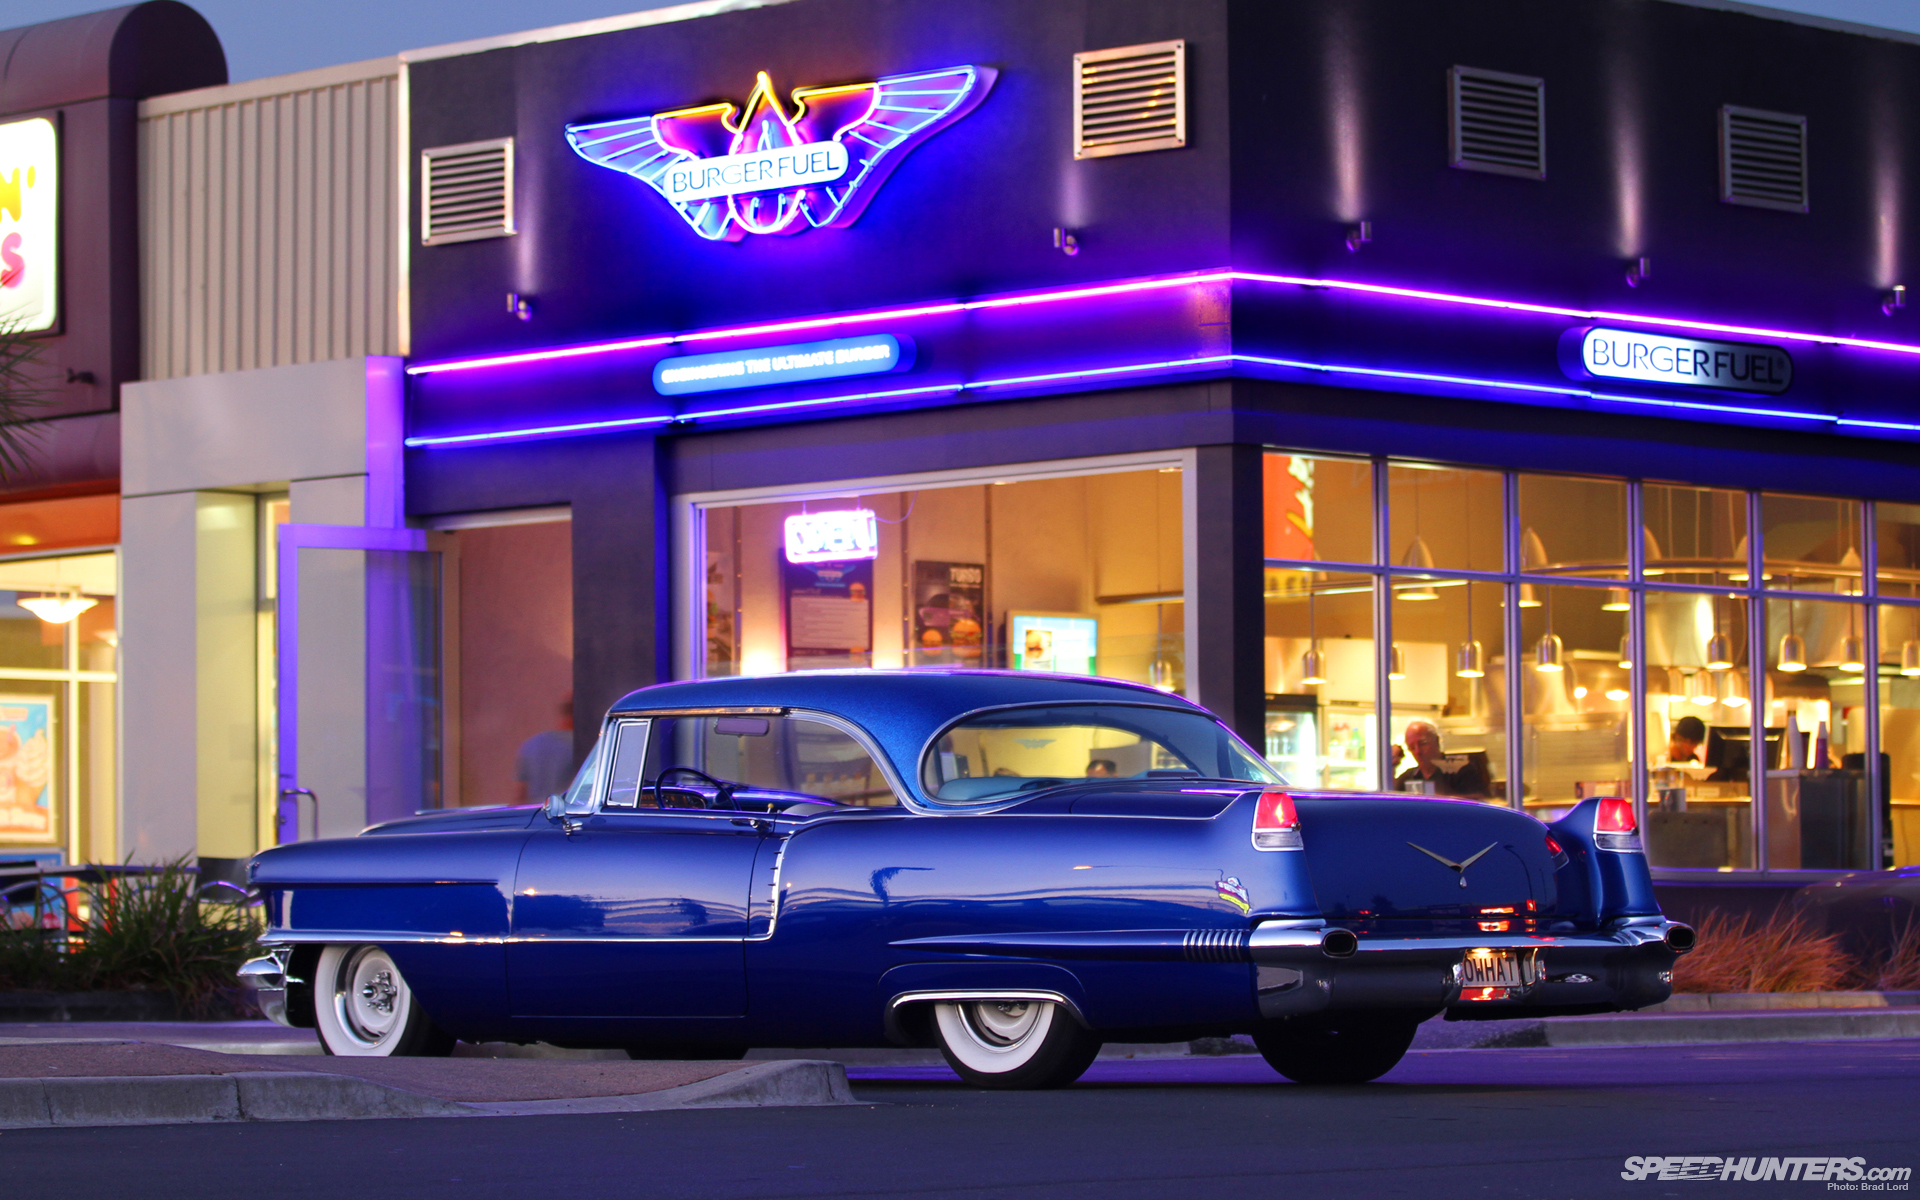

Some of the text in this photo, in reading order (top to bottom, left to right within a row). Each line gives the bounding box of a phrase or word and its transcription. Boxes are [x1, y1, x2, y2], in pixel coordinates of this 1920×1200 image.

[672, 150, 840, 193] BURGERFUEL
[745, 358, 771, 374] THE
[772, 350, 835, 371] ULTIMATE
[835, 344, 890, 365] BURGER
